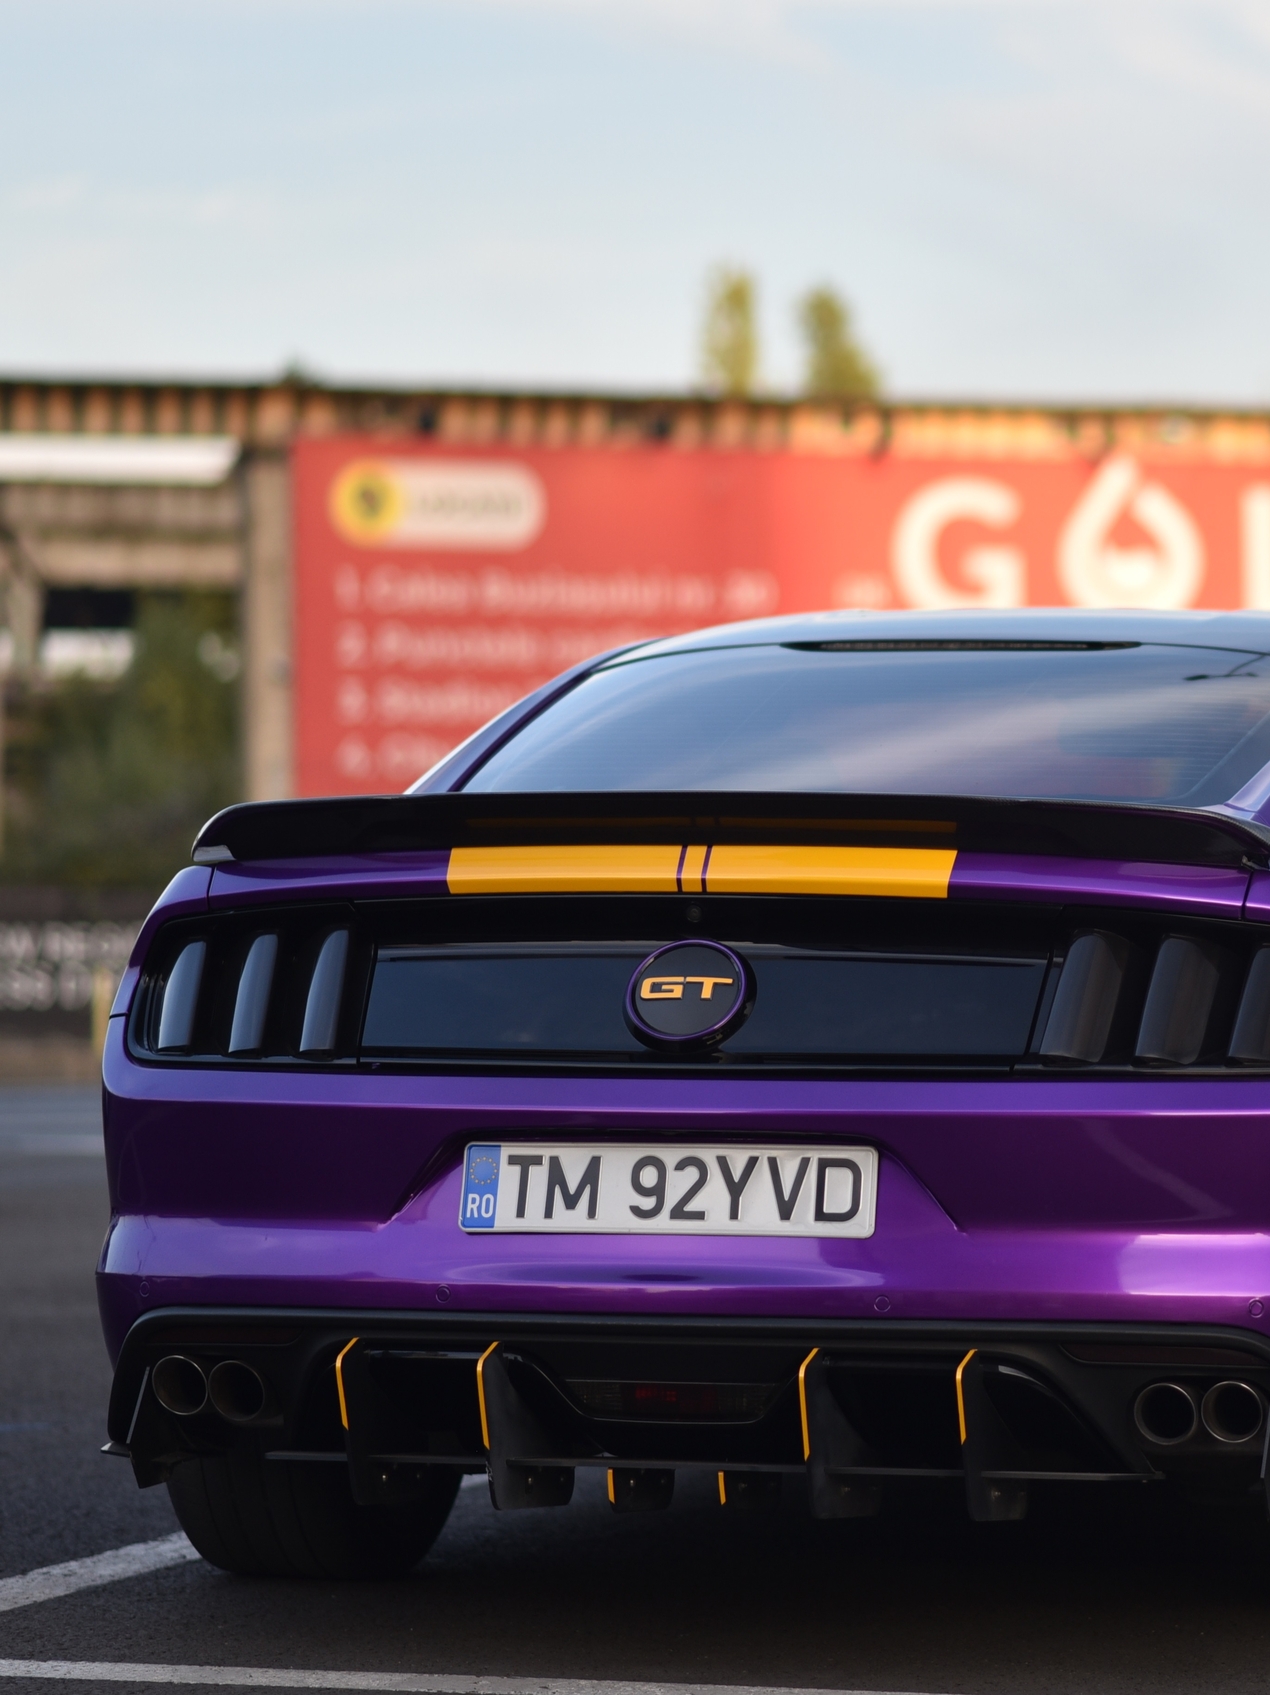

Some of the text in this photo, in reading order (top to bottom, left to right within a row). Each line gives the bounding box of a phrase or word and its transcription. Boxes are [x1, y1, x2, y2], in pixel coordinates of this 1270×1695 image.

[640, 976, 734, 999] GT
[507, 1154, 863, 1222] TM 92YVD
[466, 1193, 495, 1219] RO
